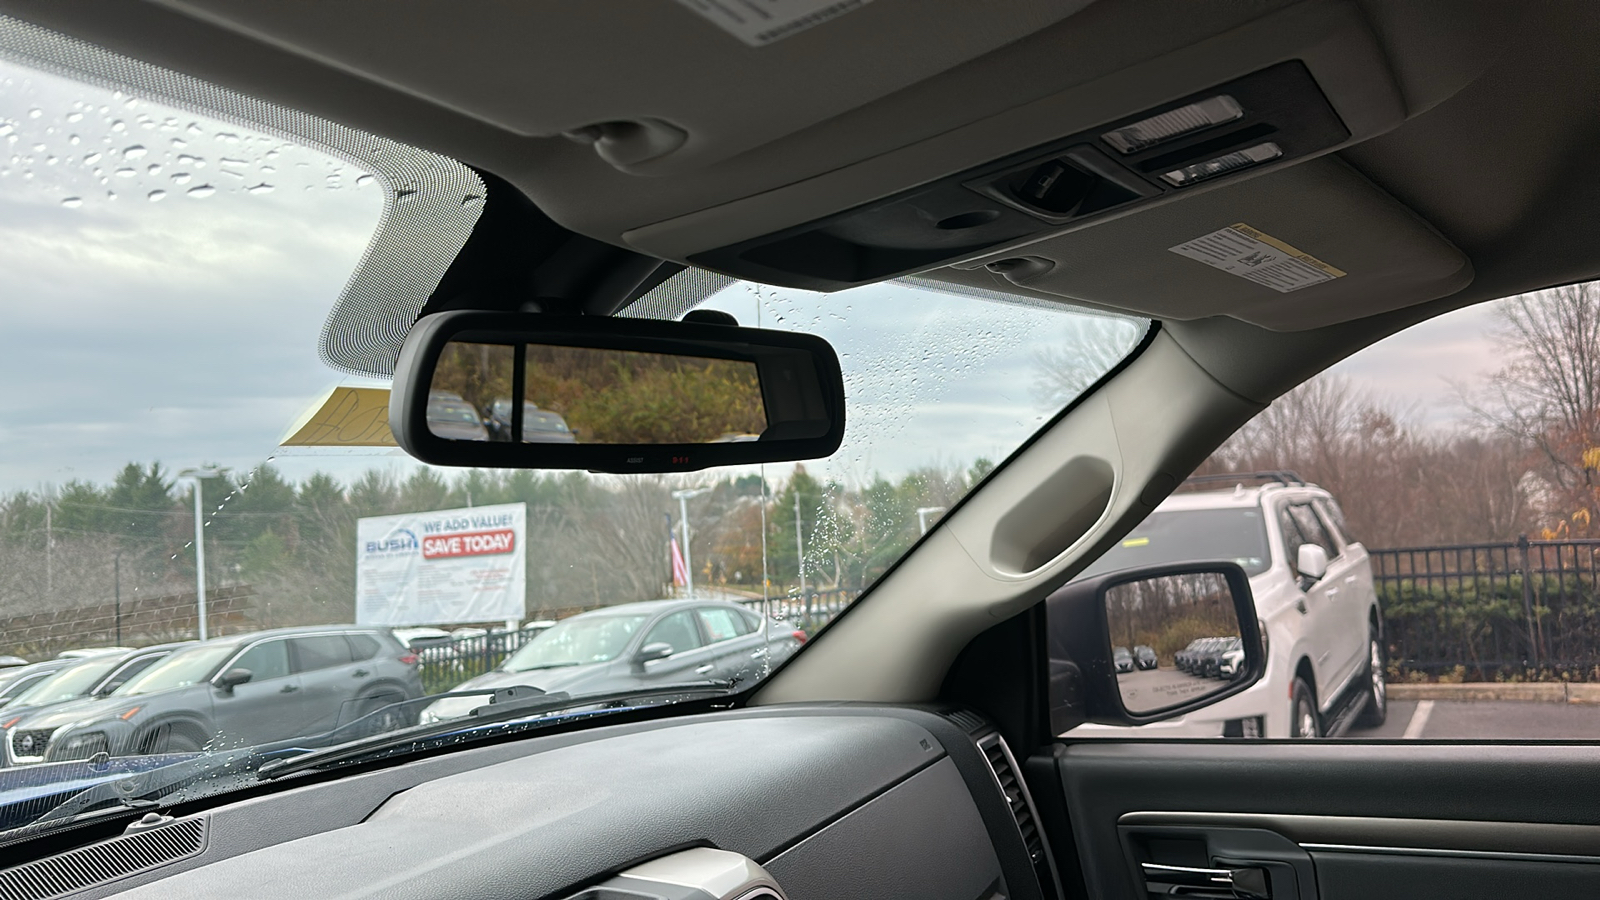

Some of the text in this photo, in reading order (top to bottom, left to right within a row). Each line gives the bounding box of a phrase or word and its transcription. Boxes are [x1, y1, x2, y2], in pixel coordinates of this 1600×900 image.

[424, 514, 513, 532] WE ADD VALUE!
[366, 539, 412, 552] BUSH
[424, 538, 461, 556] SAVE
[463, 532, 513, 552] TODAY
